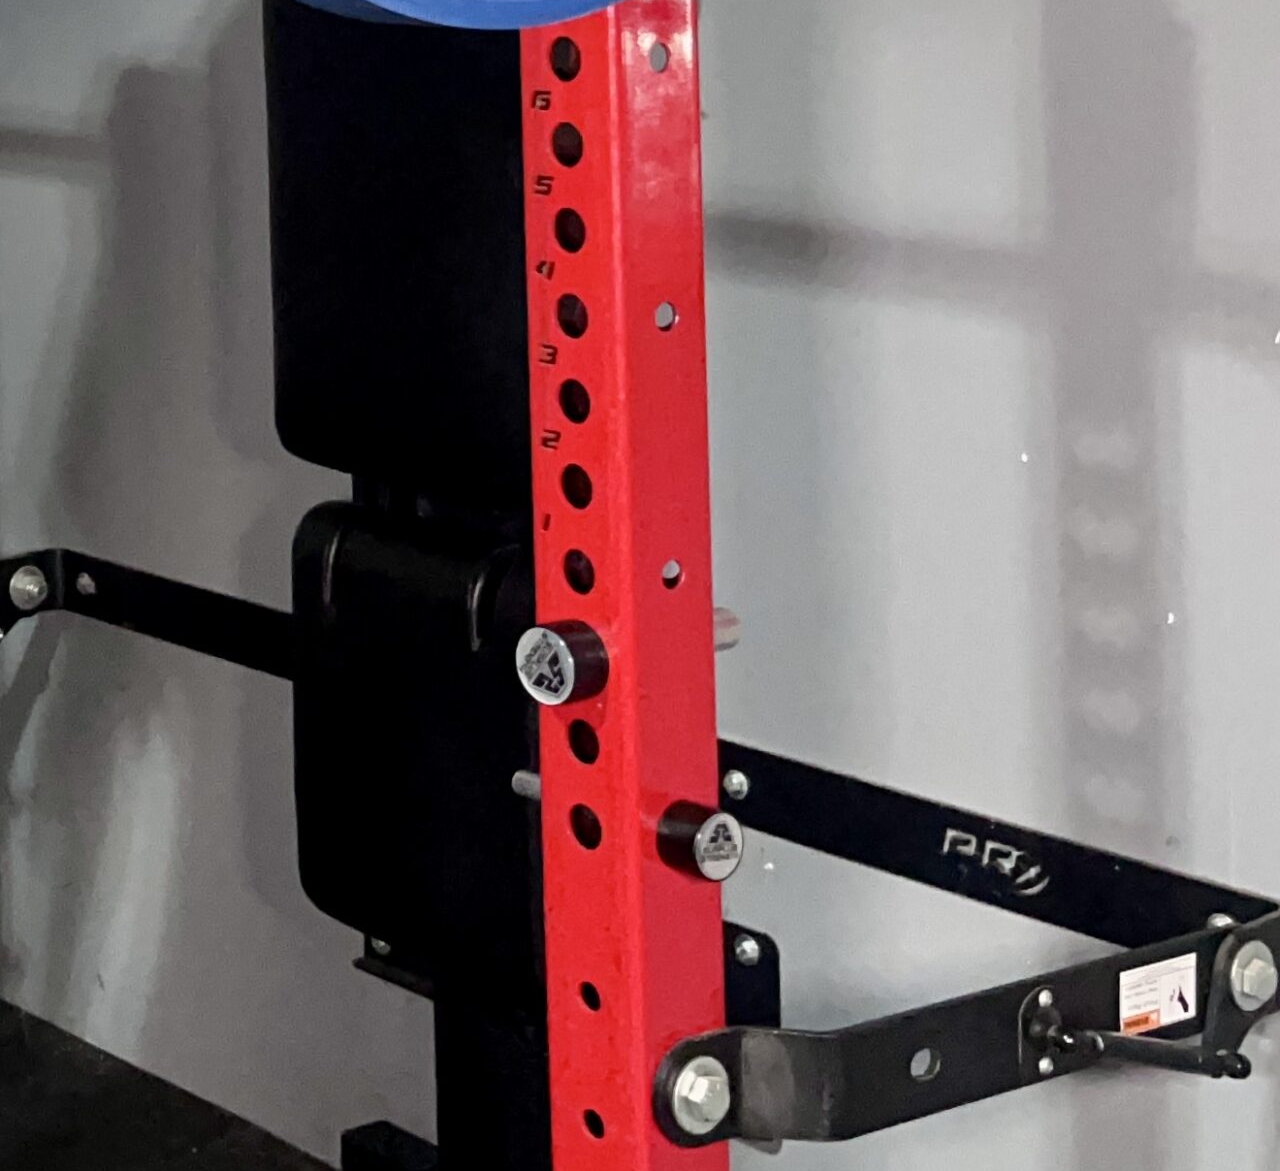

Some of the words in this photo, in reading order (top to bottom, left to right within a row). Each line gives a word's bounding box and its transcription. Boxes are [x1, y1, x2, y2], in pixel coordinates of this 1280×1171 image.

[532, 175, 554, 195] 5
[537, 344, 558, 366] 3
[540, 429, 561, 450] 2
